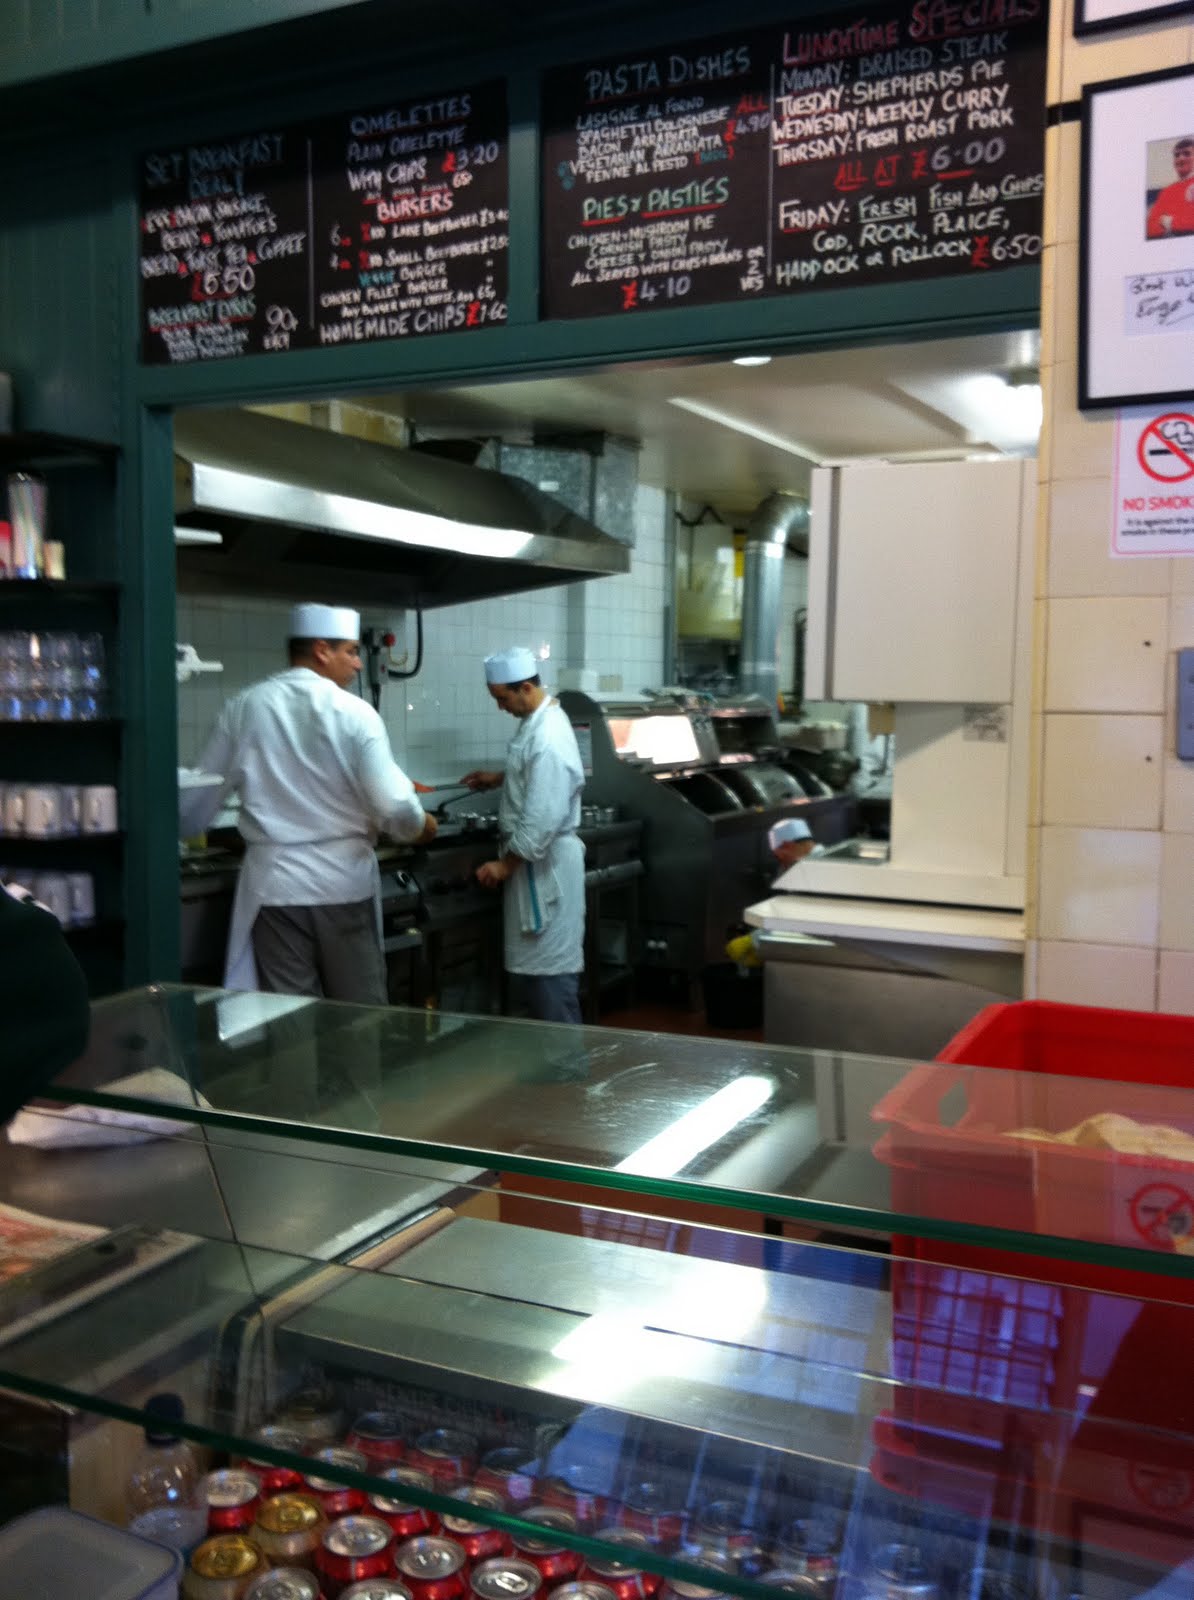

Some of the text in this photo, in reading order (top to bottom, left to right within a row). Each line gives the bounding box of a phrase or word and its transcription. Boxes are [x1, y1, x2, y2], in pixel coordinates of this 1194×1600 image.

[783, 18, 899, 64] LUNCHTIME
[859, 46, 933, 77] BRAISED
[941, 33, 1008, 62] STEAK
[585, 47, 750, 98] PASTA DISHES
[853, 65, 963, 105] SHEPHERDS
[972, 60, 1005, 82] PIE
[351, 94, 472, 137] OMELETTES
[576, 104, 640, 130] LASAGNE
[646, 101, 662, 118] AL
[736, 95, 768, 114] ALL
[865, 97, 934, 127] WEEKLY
[942, 84, 1009, 112] CURRY
[577, 122, 652, 145] SPAGHETTI
[856, 127, 898, 152] FRESH
[905, 115, 959, 142] ROAST
[968, 108, 1015, 130] PORK
[586, 167, 632, 183] PENNE
[635, 162, 651, 175] AL
[652, 157, 689, 171] PESTO
[835, 162, 868, 186] ALL
[874, 155, 902, 182] AT
[583, 196, 629, 221] PIES
[648, 177, 729, 212] PASTIES
[858, 195, 917, 220] FRESH
[930, 183, 962, 210] FISH
[968, 182, 999, 205] AND
[1001, 173, 1044, 197] CHIPS
[694, 215, 716, 231] PIE
[776, 254, 858, 285] HADDOCK
[892, 237, 971, 266] POLLOCK
[320, 312, 411, 344] HOMEMADE
[414, 303, 465, 332] CHIPS
[1123, 499, 1144, 511] NO
